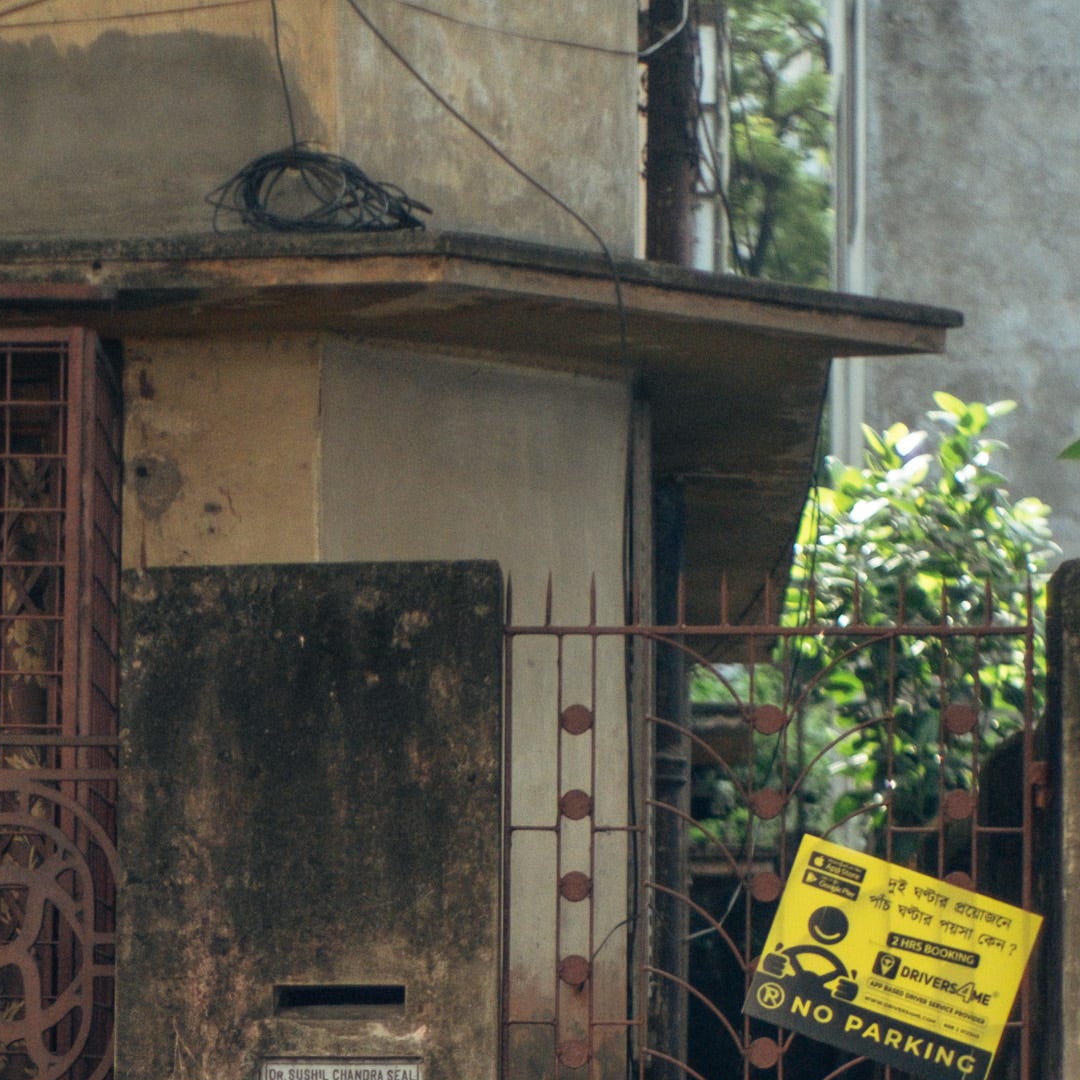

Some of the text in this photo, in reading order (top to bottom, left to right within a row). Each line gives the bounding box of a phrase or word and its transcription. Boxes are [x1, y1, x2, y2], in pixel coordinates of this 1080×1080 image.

[888, 877, 908, 894] দুই
[869, 892, 892, 912] পাঁচ
[891, 935, 975, 965] 2 HRS BOOKING
[900, 966, 992, 1006] DRIVERS4ME
[870, 980, 986, 1025] APP BASED DRIVER SERVICE PROVIDER
[790, 996, 834, 1024] NO
[843, 1013, 976, 1074] PARKING
[288, 1068, 329, 1080] SUSHIL
[332, 1069, 384, 1080] CHANDRA
[387, 1069, 416, 1080] SEAL
